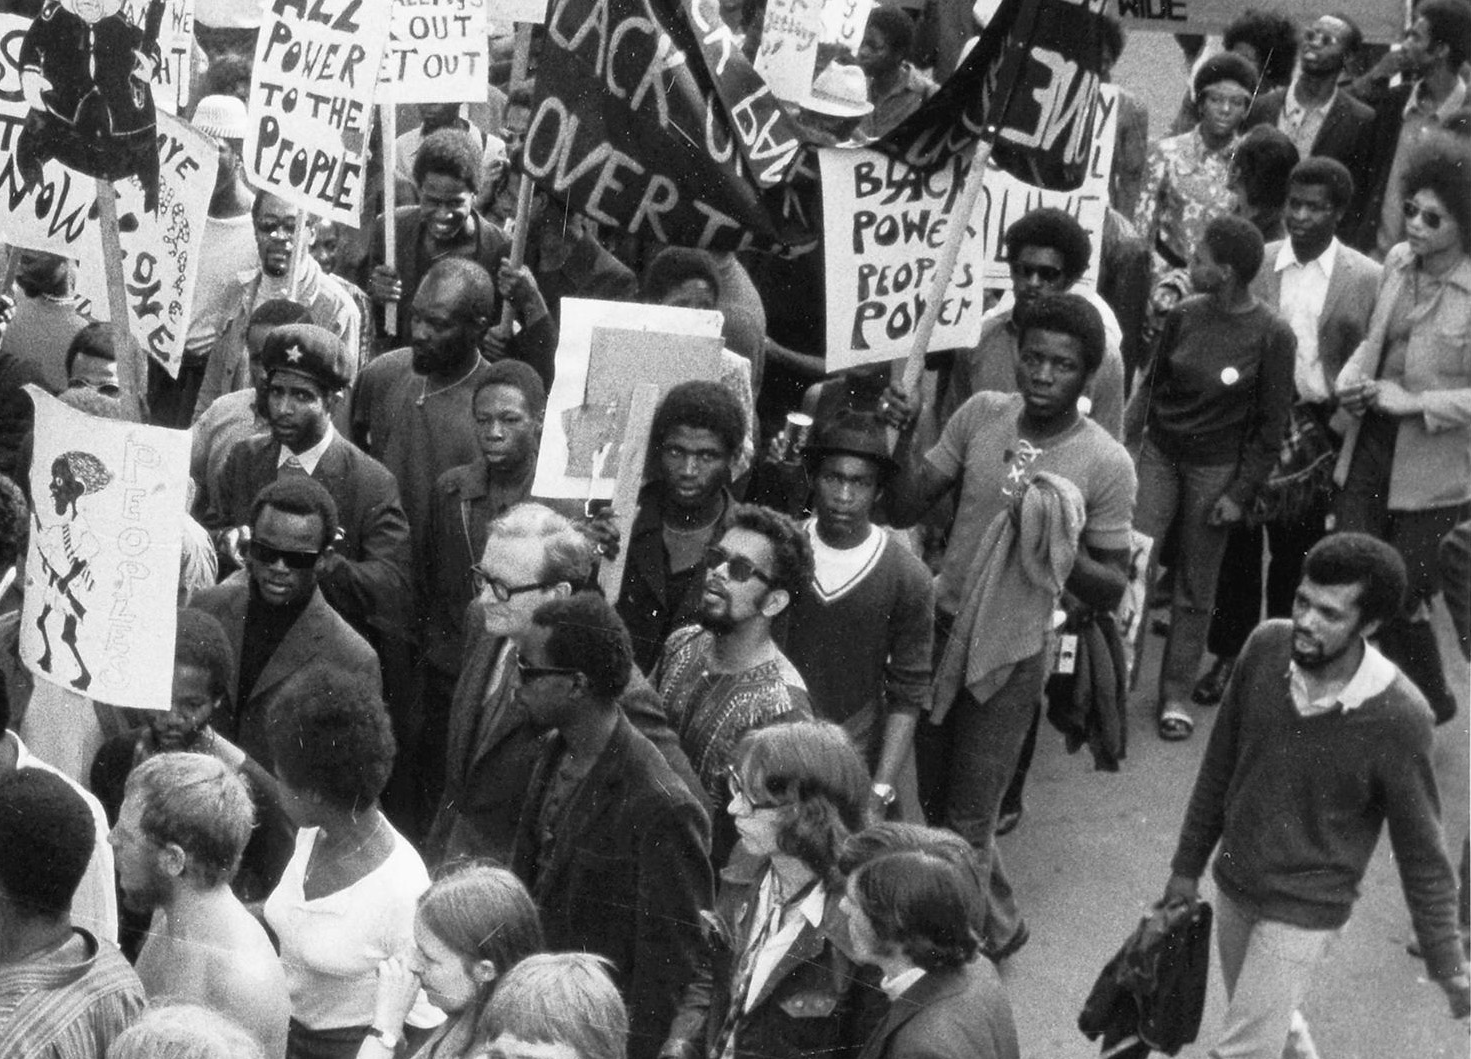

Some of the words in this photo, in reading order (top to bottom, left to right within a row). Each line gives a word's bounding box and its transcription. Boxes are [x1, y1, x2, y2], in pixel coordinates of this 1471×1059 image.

[409, 14, 472, 40] OUT
[263, 20, 365, 88] POWER
[423, 52, 480, 79] OUT
[260, 82, 298, 114] TO
[306, 92, 364, 132] THE
[254, 115, 362, 211] PEOPLE
[523, 97, 679, 244] OVER
[853, 210, 976, 255] POWE
[858, 258, 973, 303] PEOPS
